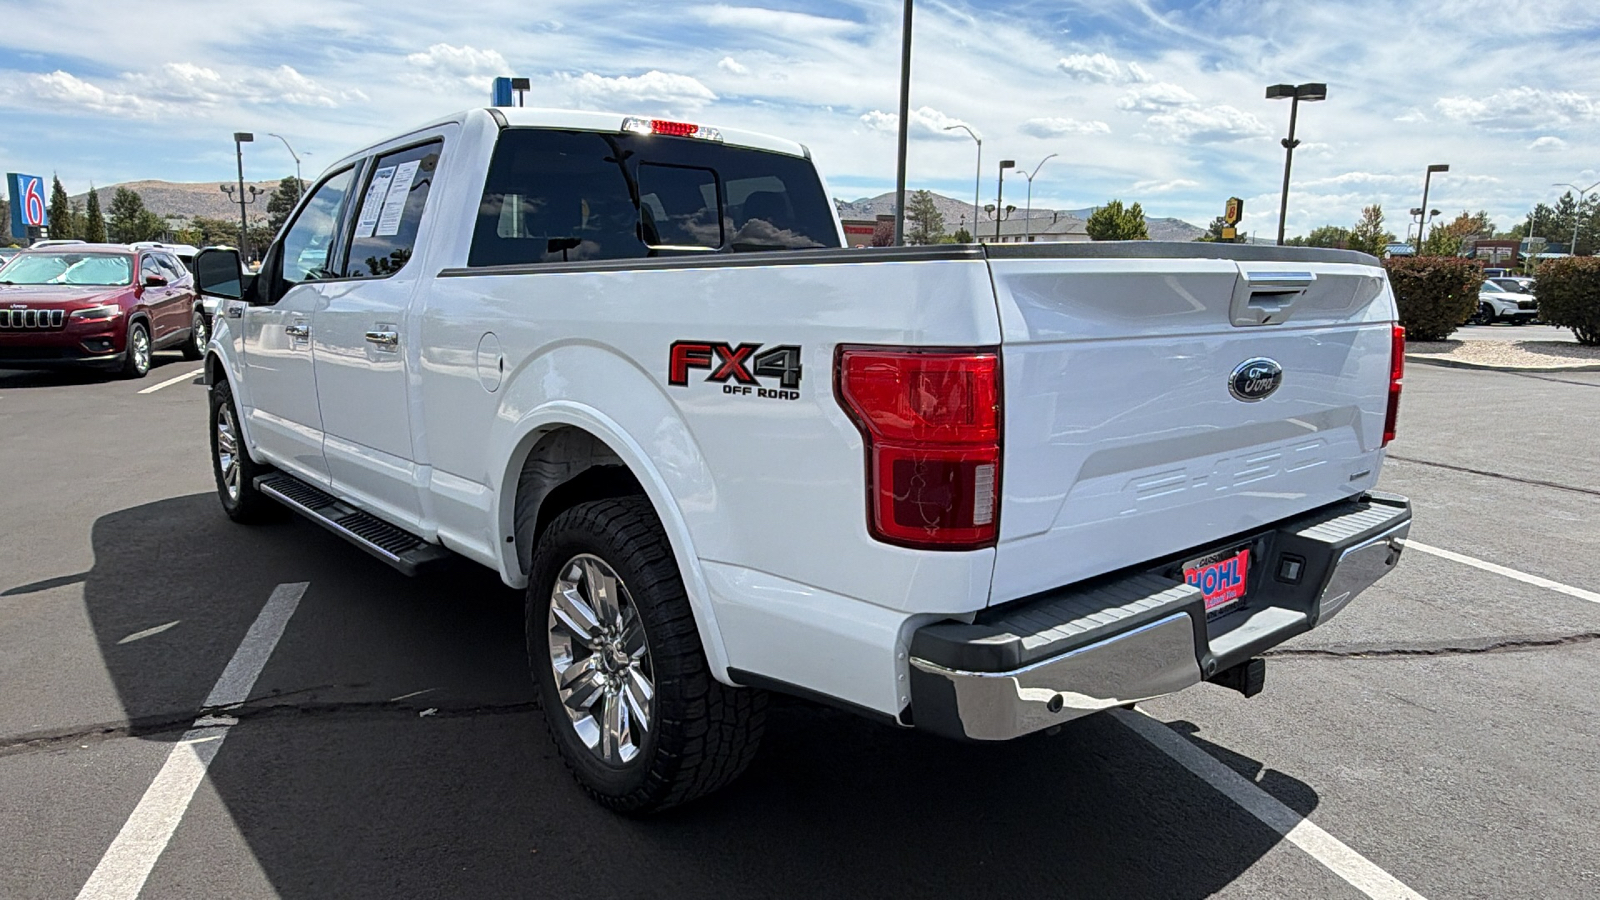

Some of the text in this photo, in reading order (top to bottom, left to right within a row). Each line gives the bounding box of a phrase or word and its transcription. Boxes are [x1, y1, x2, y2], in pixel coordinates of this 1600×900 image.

[25, 178, 44, 226] 6
[1227, 206, 1236, 218] 8
[668, 339, 802, 390] FX4
[1244, 367, 1274, 393] Ford
[723, 384, 800, 401] OFF ROAD
[1186, 558, 1242, 596] HOHL
